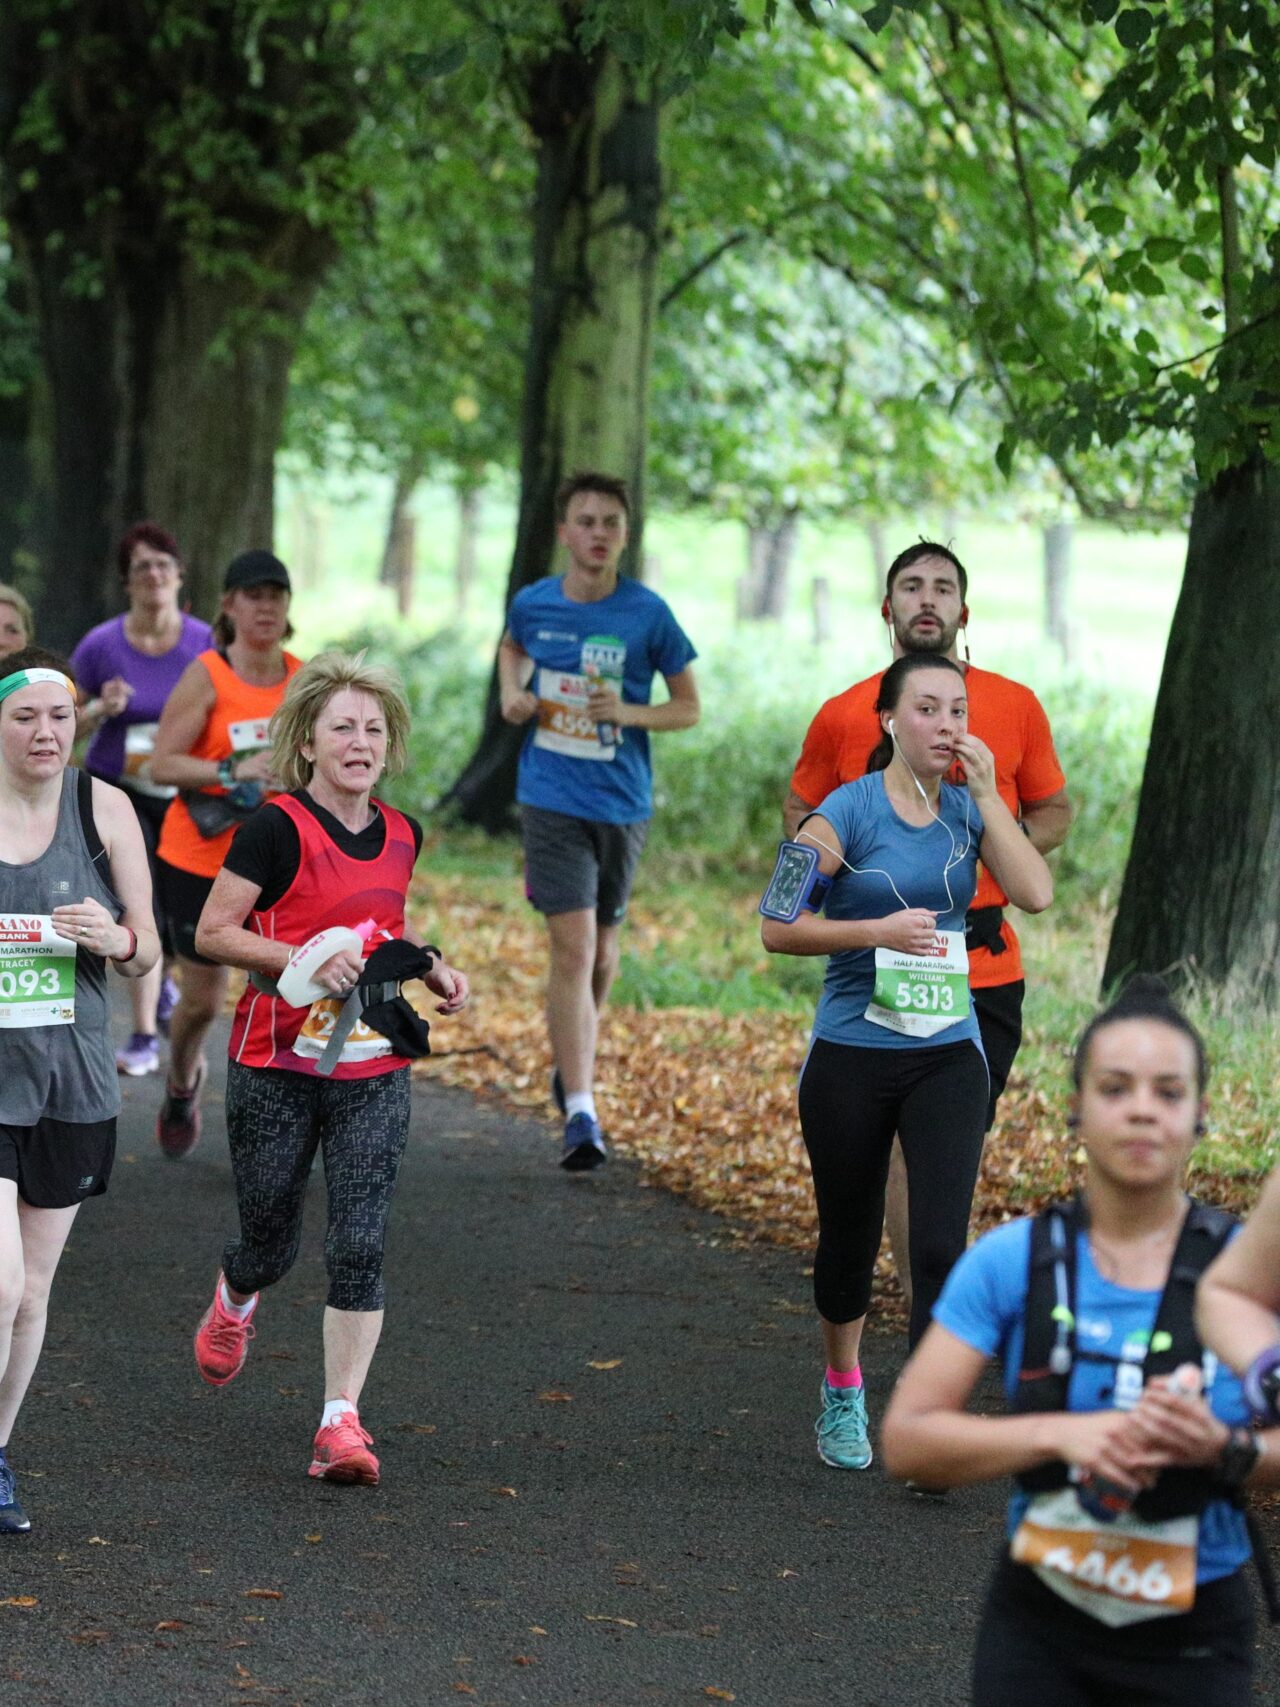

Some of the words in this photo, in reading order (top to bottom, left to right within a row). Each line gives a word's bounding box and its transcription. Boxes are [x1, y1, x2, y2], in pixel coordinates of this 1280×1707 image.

[0, 959, 36, 969] TRACEY
[893, 960, 914, 968] HALF
[915, 961, 955, 971] MARATHON
[908, 972, 946, 983] WILLIAMS
[895, 982, 955, 1012] 5313
